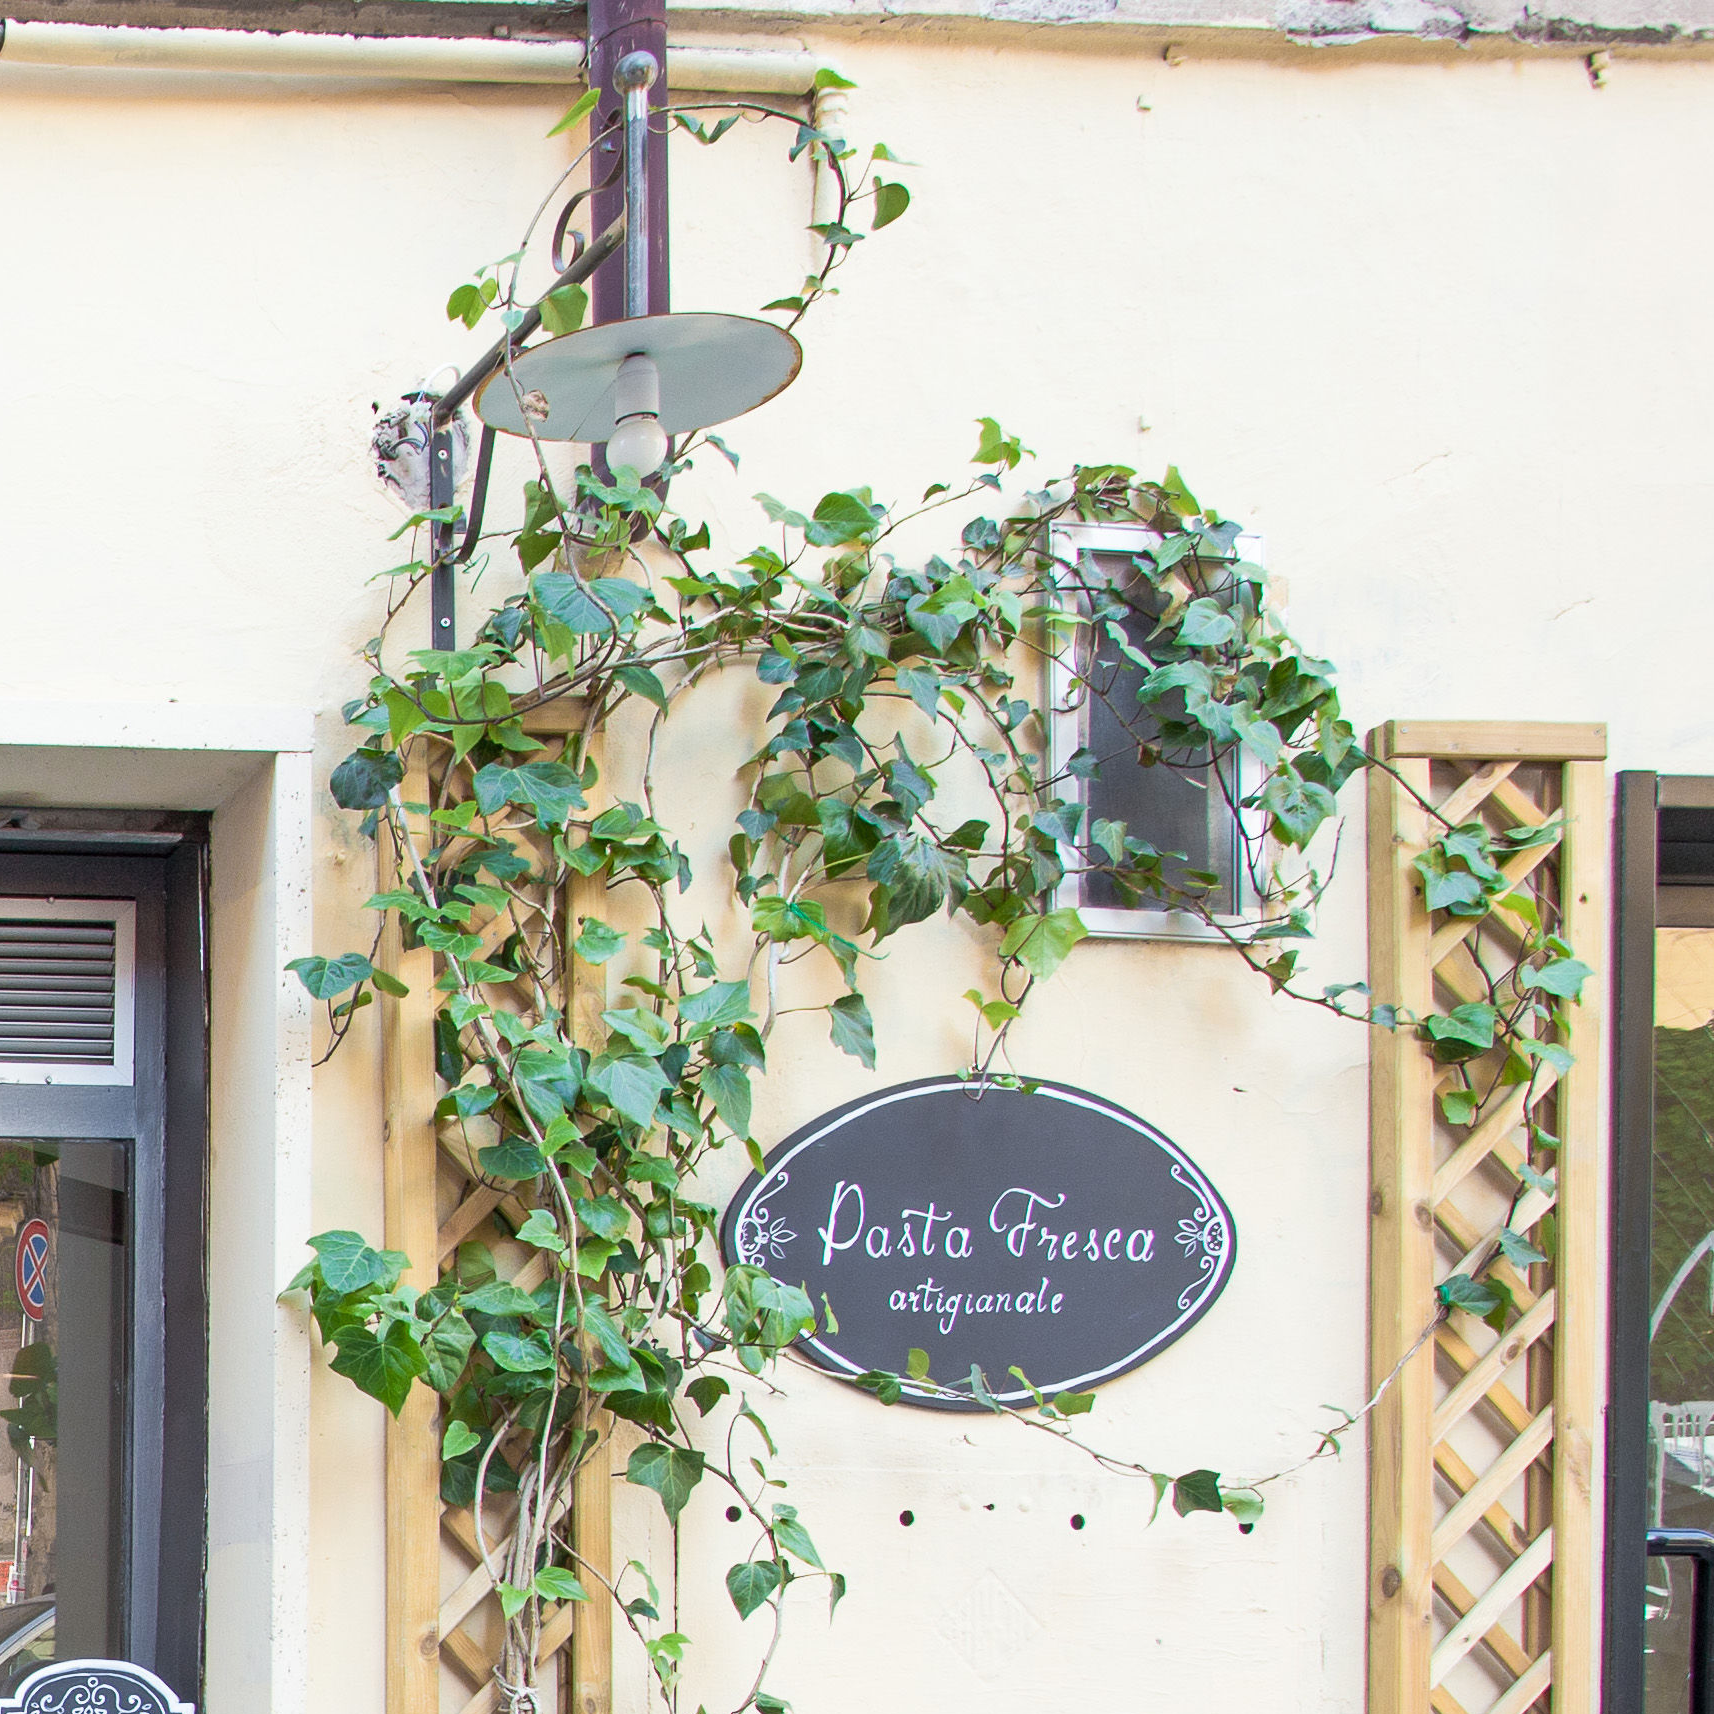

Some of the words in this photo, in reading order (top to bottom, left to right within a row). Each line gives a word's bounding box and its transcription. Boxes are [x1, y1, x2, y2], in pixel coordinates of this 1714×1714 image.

[819, 1180, 973, 1266] Pasta
[988, 1187, 1155, 1263] Fresca
[888, 1276, 1065, 1336] artigianale
